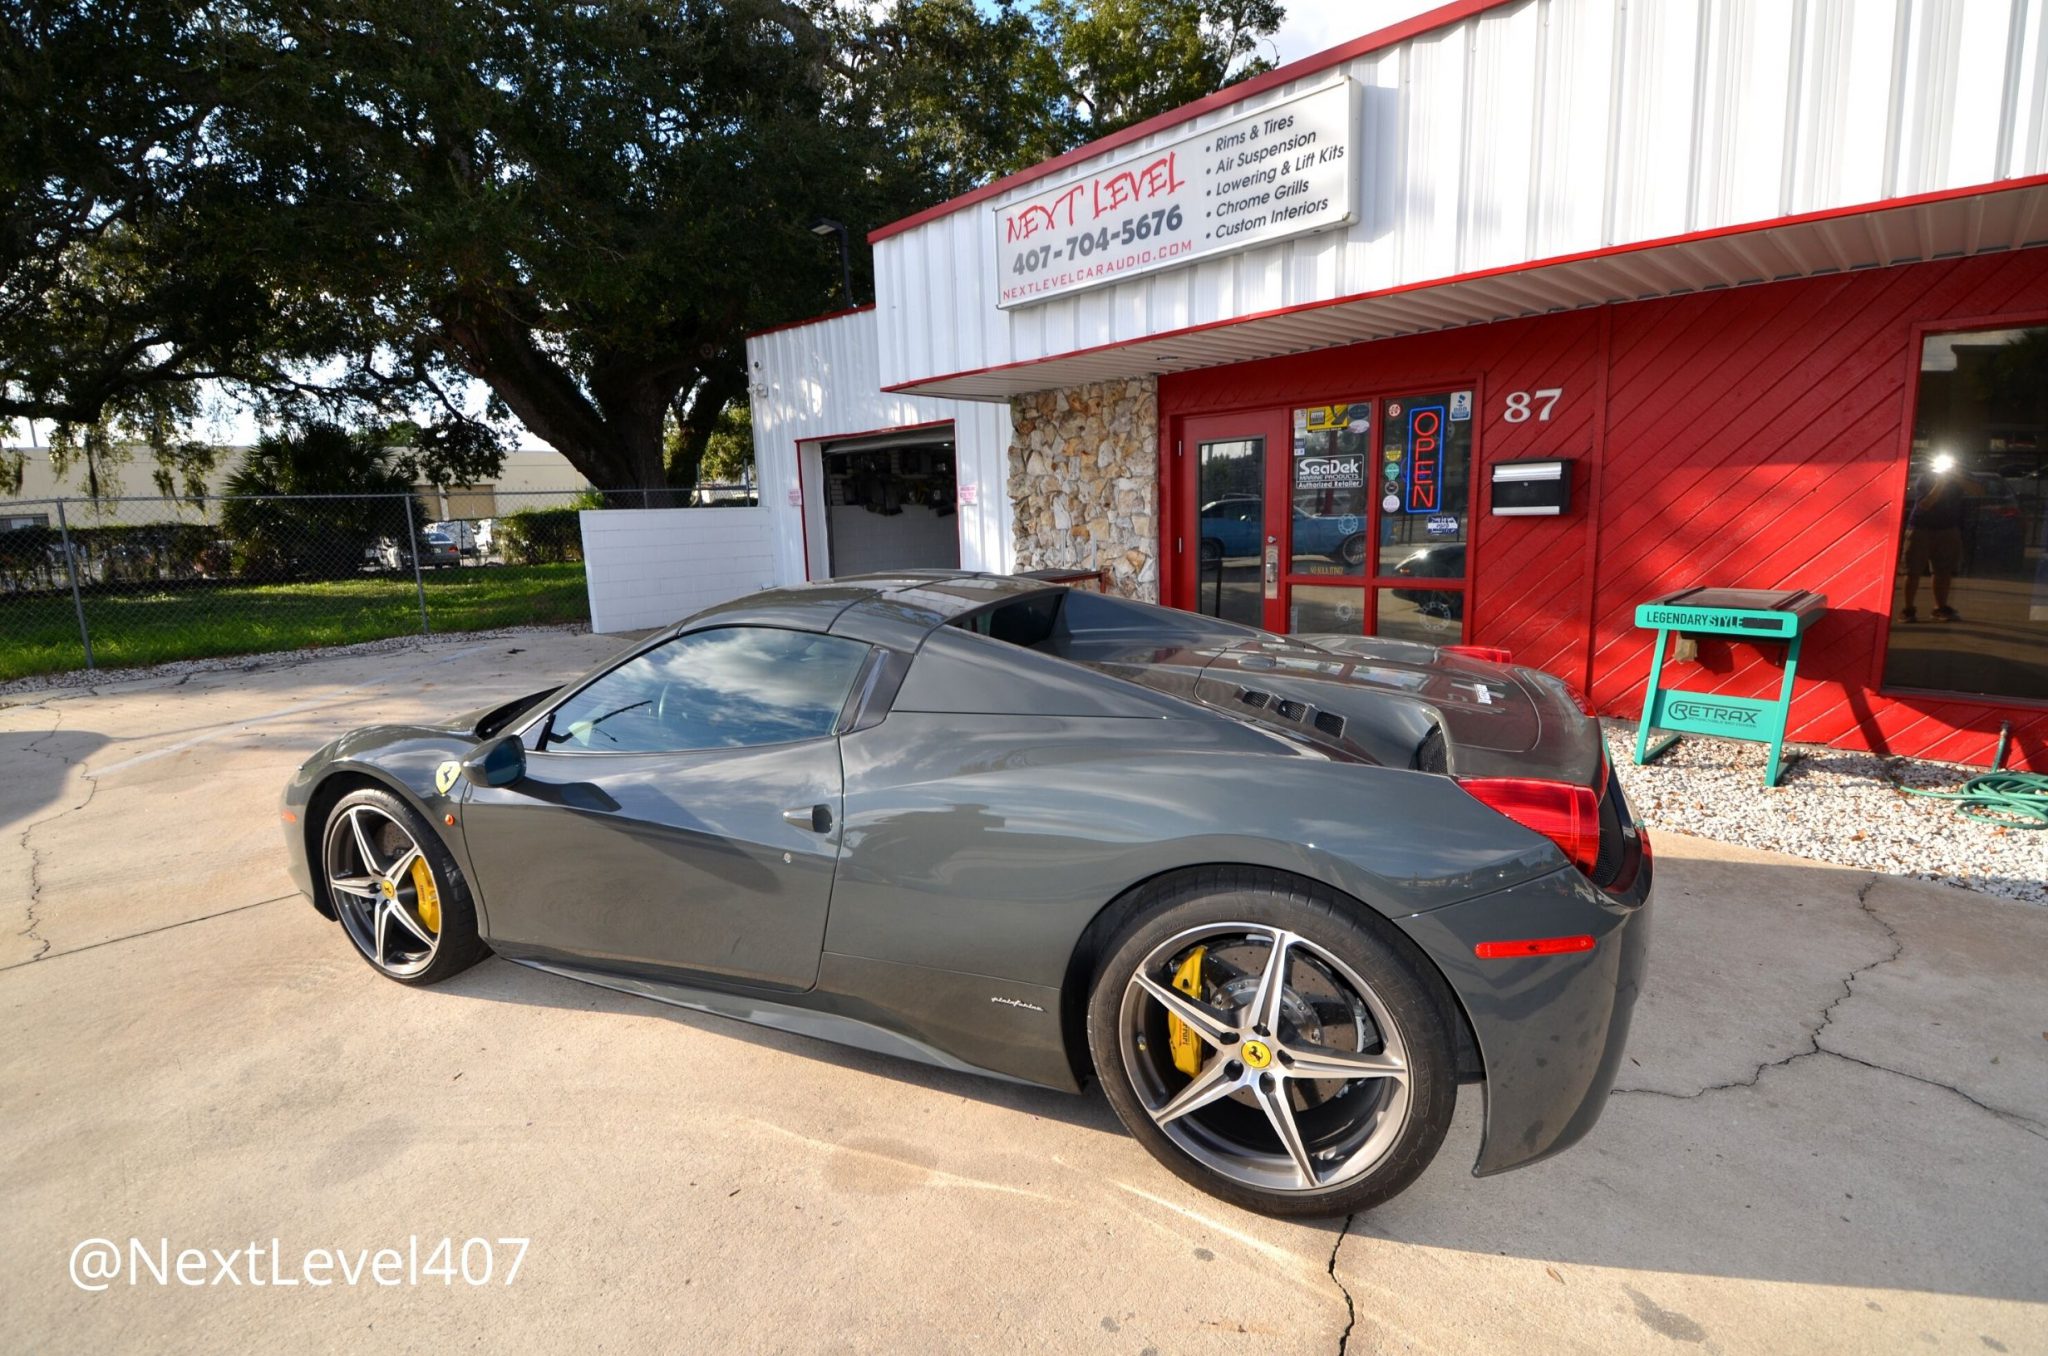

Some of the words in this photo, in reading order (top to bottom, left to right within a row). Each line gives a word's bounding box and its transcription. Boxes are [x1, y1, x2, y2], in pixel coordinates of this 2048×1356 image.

[1215, 132, 1246, 152] Rims
[1249, 125, 1259, 141] &
[1264, 115, 1294, 135] Tires
[1215, 157, 1234, 174] Air
[1237, 131, 1316, 167] Suspension
[1216, 167, 1277, 196] Lowering
[1281, 161, 1290, 176] &
[1295, 152, 1315, 172] Lift
[1319, 145, 1344, 164] Kits
[1007, 185, 1084, 244] NEXT
[1093, 152, 1185, 219] LEVEL
[1215, 214, 1267, 239] Custom
[1271, 198, 1328, 224] Interiors
[1216, 192, 1270, 217] Chrome
[1274, 179, 1309, 200] Grills
[1012, 204, 1183, 275] 407-704-5676
[1003, 240, 1192, 300] NEXTLEVELCARAUDIO.COM
[1504, 388, 1562, 423] 87
[1299, 458, 1359, 475] SeaDek
[1413, 411, 1439, 507] OPEN
[1299, 481, 1333, 489] Authorized
[1334, 480, 1360, 488] Retailer
[1668, 700, 1762, 724] RETRAX
